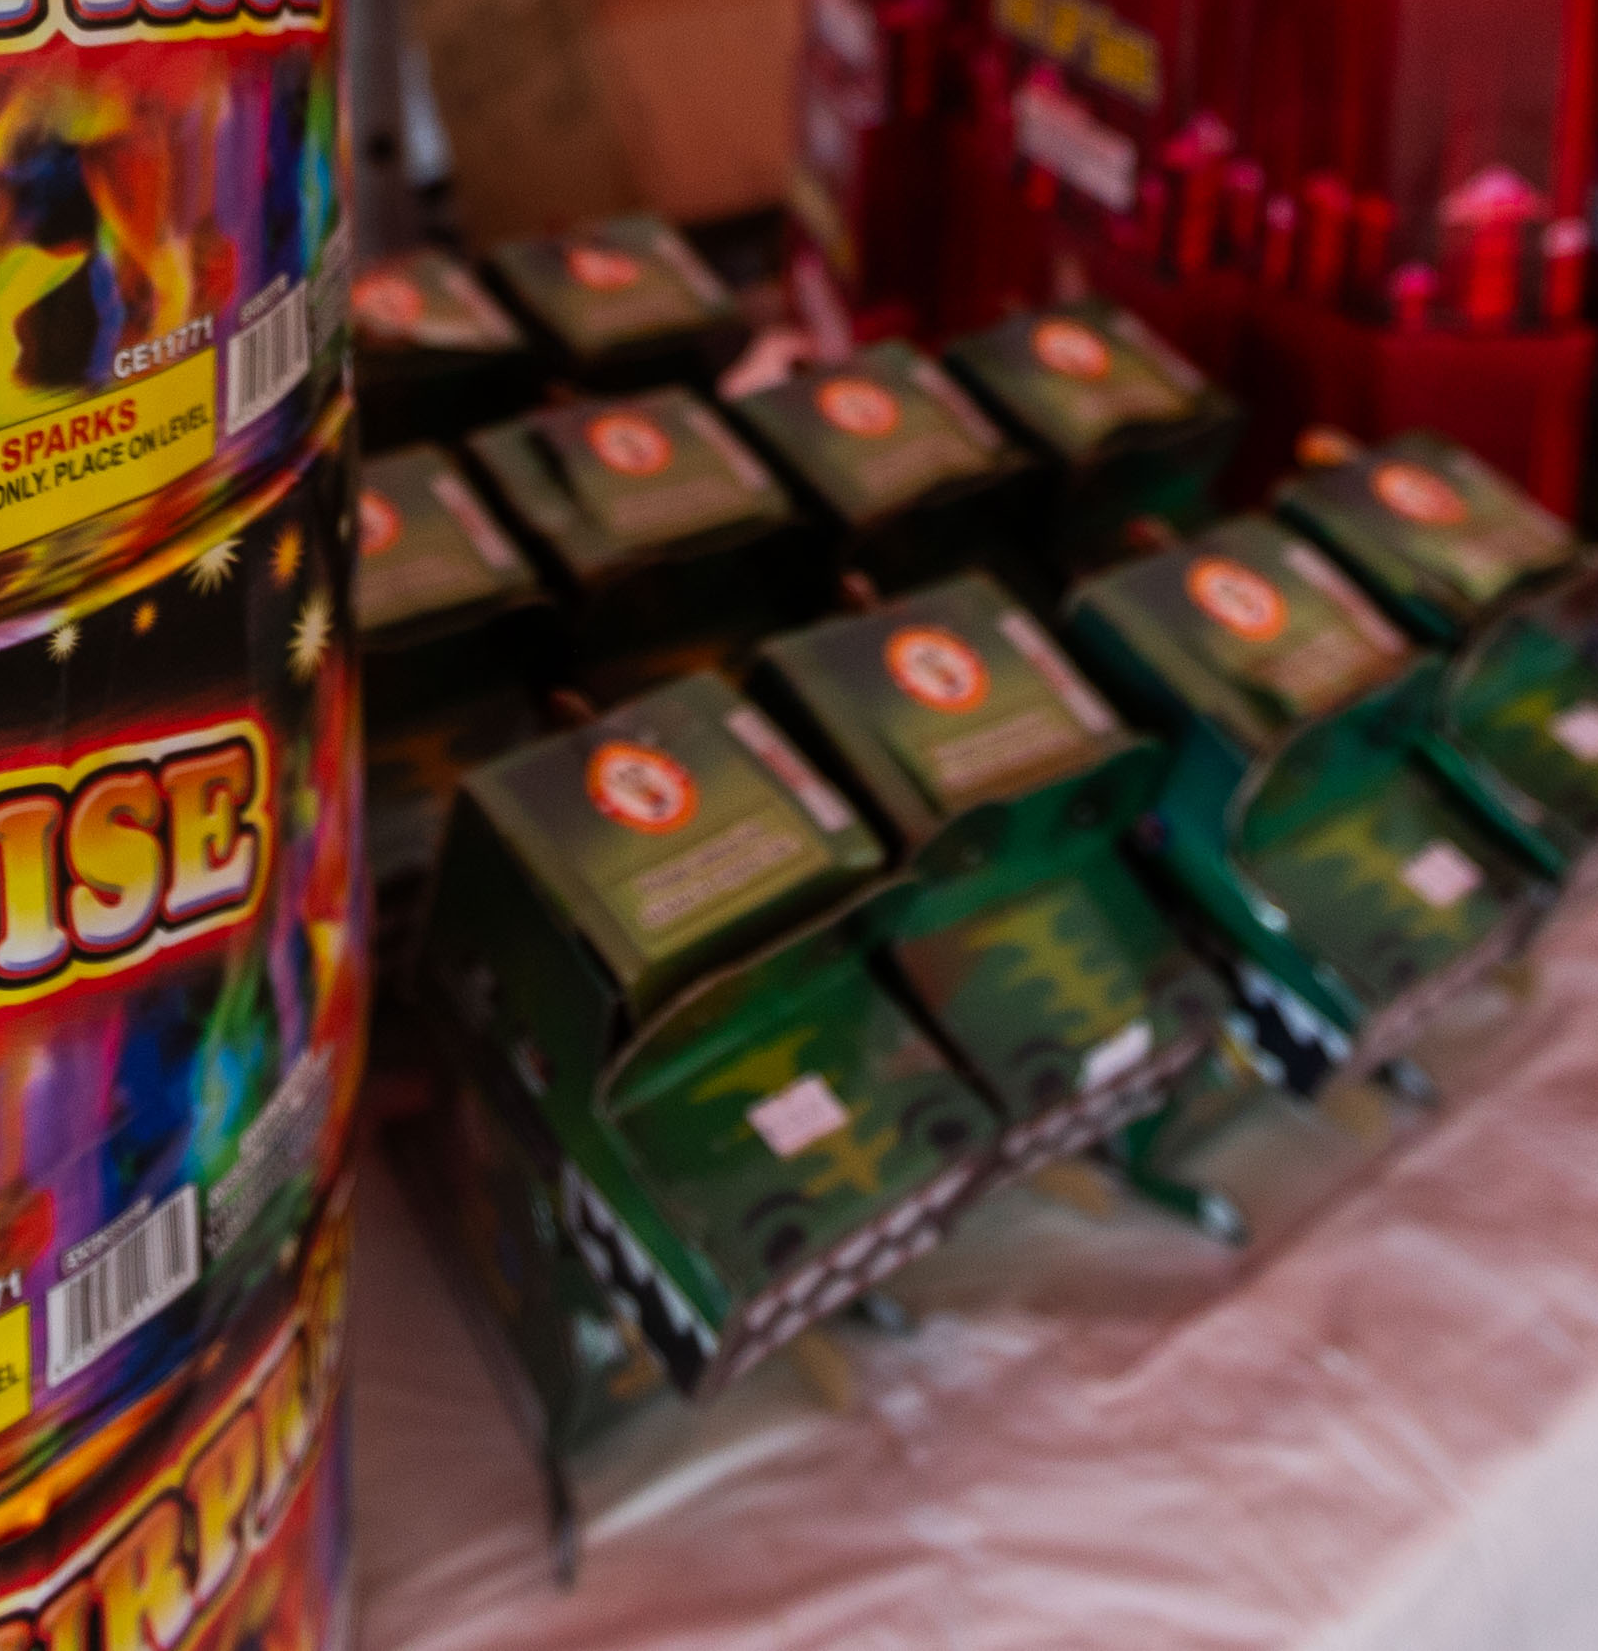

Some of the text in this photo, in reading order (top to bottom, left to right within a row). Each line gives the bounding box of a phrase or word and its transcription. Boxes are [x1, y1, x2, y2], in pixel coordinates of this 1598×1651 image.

[113, 314, 213, 379] CE11771
[0, 398, 138, 473] SPARKS
[54, 448, 123, 492] PLACE
[128, 433, 157, 459] ON
[159, 402, 211, 448] LEVEL
